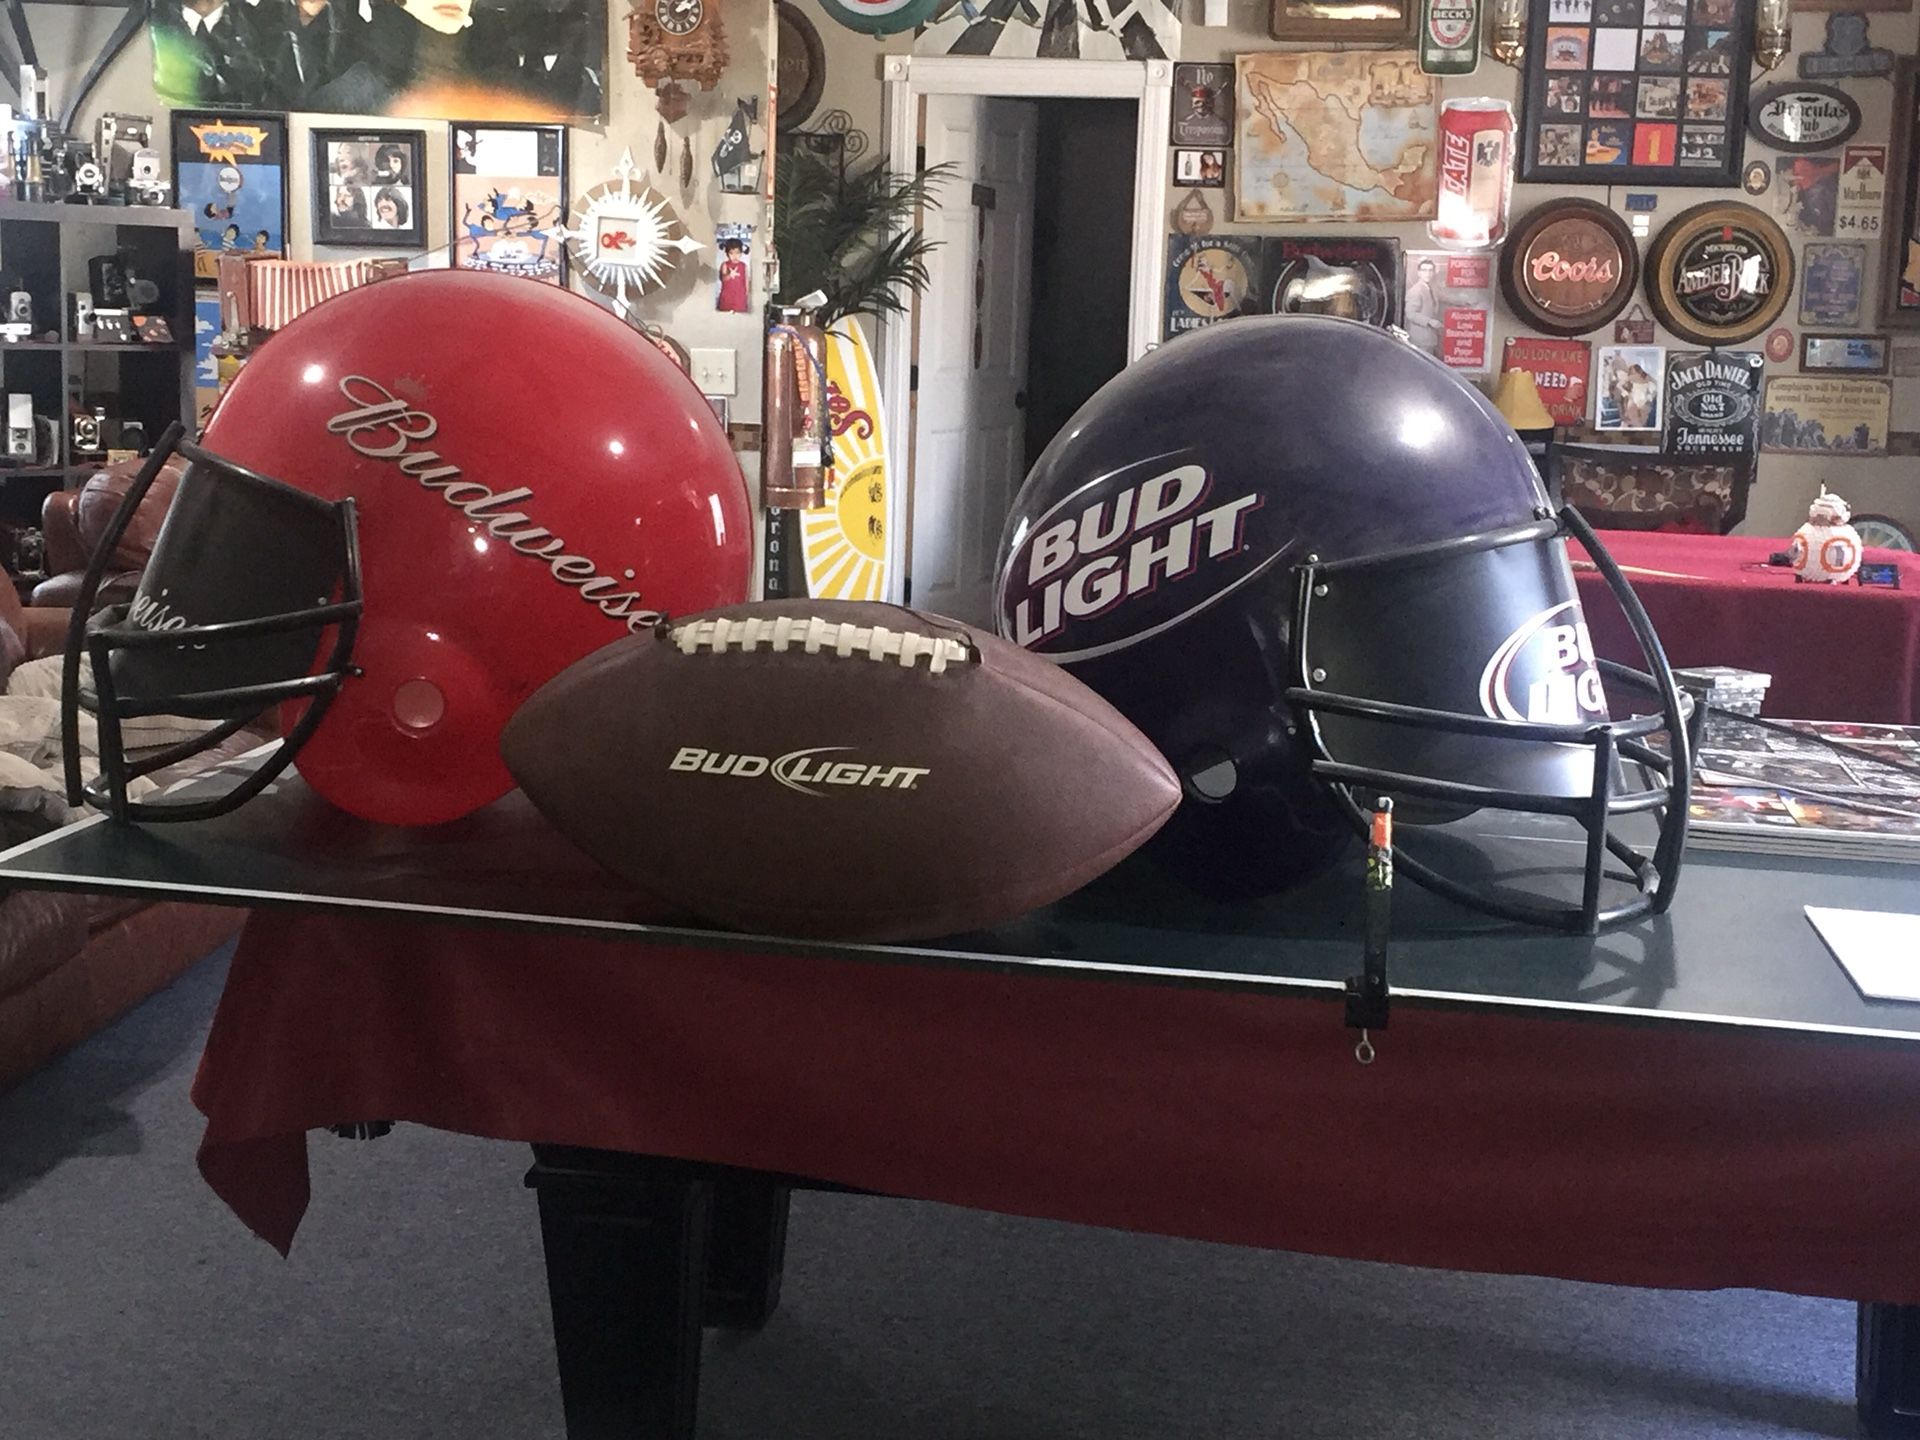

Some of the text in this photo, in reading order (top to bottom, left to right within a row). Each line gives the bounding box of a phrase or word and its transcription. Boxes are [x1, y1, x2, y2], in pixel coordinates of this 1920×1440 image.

[1432, 9, 1472, 19] BECK'S
[1767, 100, 1848, 122] Drculas
[1839, 215, 1880, 232] $4.65
[1531, 251, 1614, 284] Coors
[1676, 263, 1731, 294] AMBER
[1715, 252, 1770, 301] BK
[1535, 371, 1568, 388] NEED
[1671, 365, 1704, 391] JACK
[1551, 402, 1583, 416] DRINK
[1702, 394, 1723, 403] Old
[1677, 427, 1744, 445] Tennessee
[327, 375, 663, 634] Budweise
[1028, 464, 1212, 588] BUD
[768, 505, 780, 590] orona
[1016, 493, 1262, 648] LIGHT
[669, 747, 931, 789] BUD LIGHT
